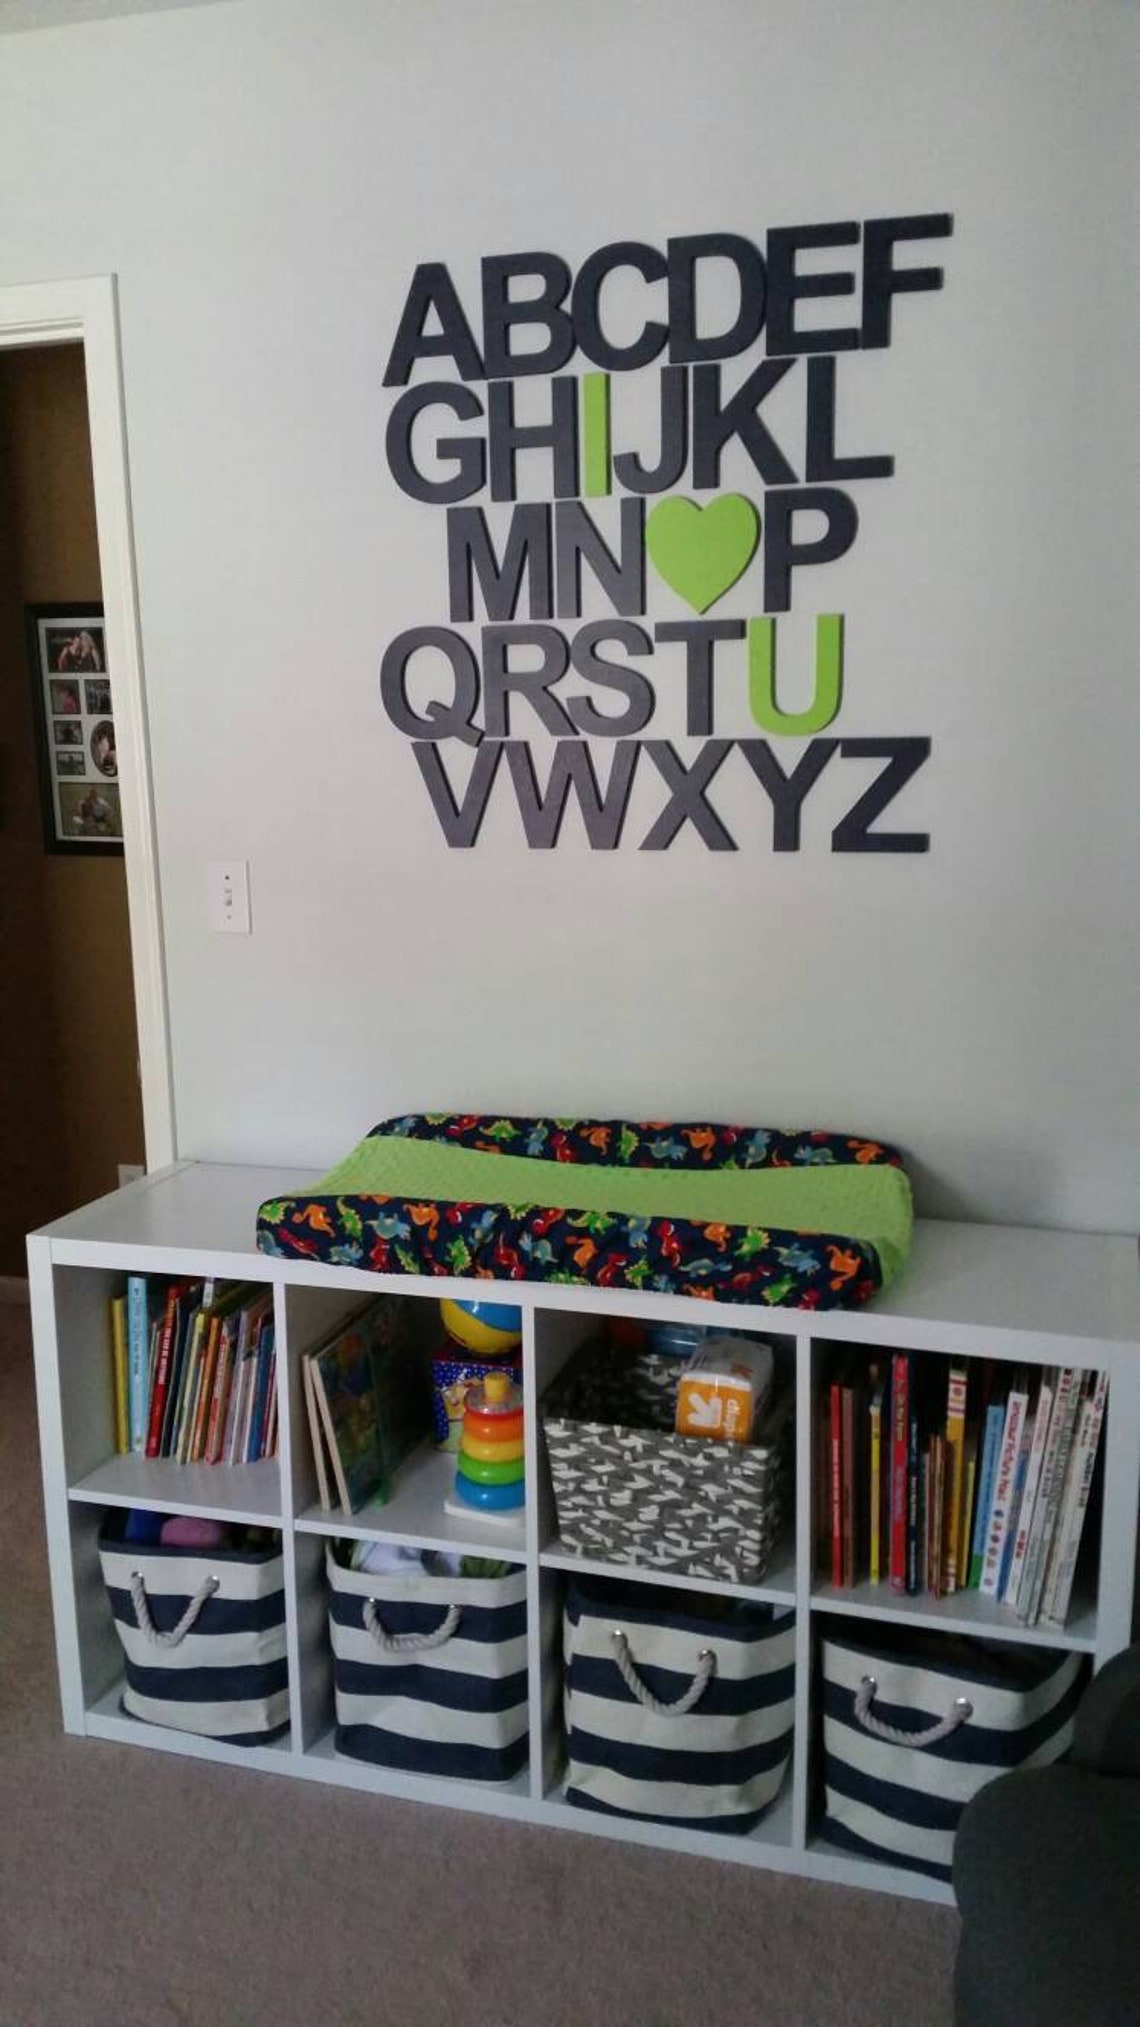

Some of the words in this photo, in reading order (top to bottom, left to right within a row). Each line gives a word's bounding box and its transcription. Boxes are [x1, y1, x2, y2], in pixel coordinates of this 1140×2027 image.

[382, 213, 953, 387] ABCDEF
[385, 355, 894, 504] GHIJKL
[380, 613, 844, 748] QRSTU
[412, 736, 931, 853] VWXYZ
